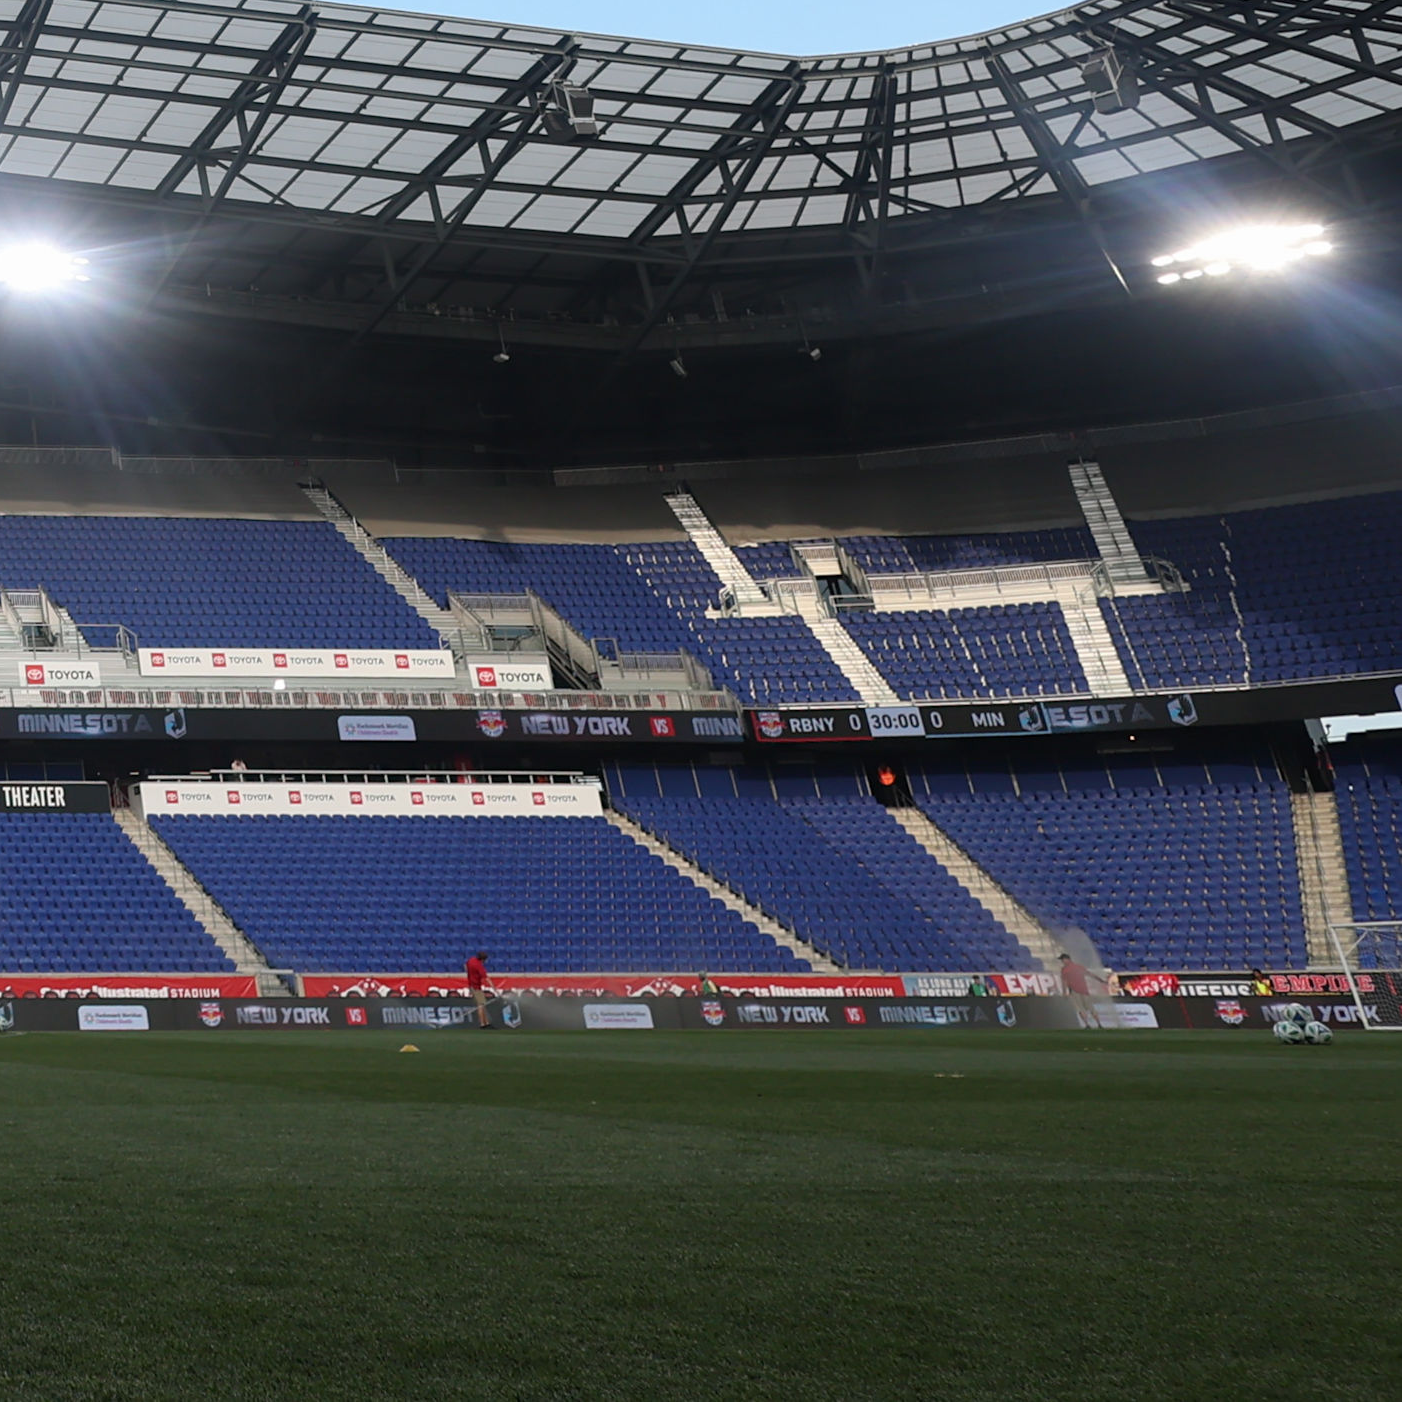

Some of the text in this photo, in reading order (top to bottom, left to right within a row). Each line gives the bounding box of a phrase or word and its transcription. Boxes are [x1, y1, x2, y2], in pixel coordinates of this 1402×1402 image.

[168, 656, 445, 667] TOYOTA TOYOTA TOYOTA TOYOTA TOYOTA
[48, 670, 94, 681] TOYOTA
[499, 672, 544, 684] TOYOTA
[17, 713, 152, 734] MINNESOTA
[520, 715, 571, 736] NEW
[573, 717, 633, 736] YORK
[652, 718, 669, 734] VS
[789, 713, 862, 734] RBNY 0
[872, 711, 920, 730] 30:00
[929, 710, 1006, 729] 0 MIN
[3, 786, 65, 807] THEATER
[181, 793, 578, 803] TOYOTA TOYOTA TOYOTA TOYOTA TOYOTA TOYOTA TOYOTA
[845, 988, 894, 998] STADIUM
[1269, 974, 1376, 993] EMPIRE
[169, 989, 220, 999] STADIUM
[236, 1006, 477, 1025] NEW YORK VS MINNESOT
[737, 1005, 776, 1024] NEW
[780, 1006, 830, 1024] YORK
[879, 1006, 988, 1025] MINNESOTA
[1316, 1005, 1381, 1022] YORK
